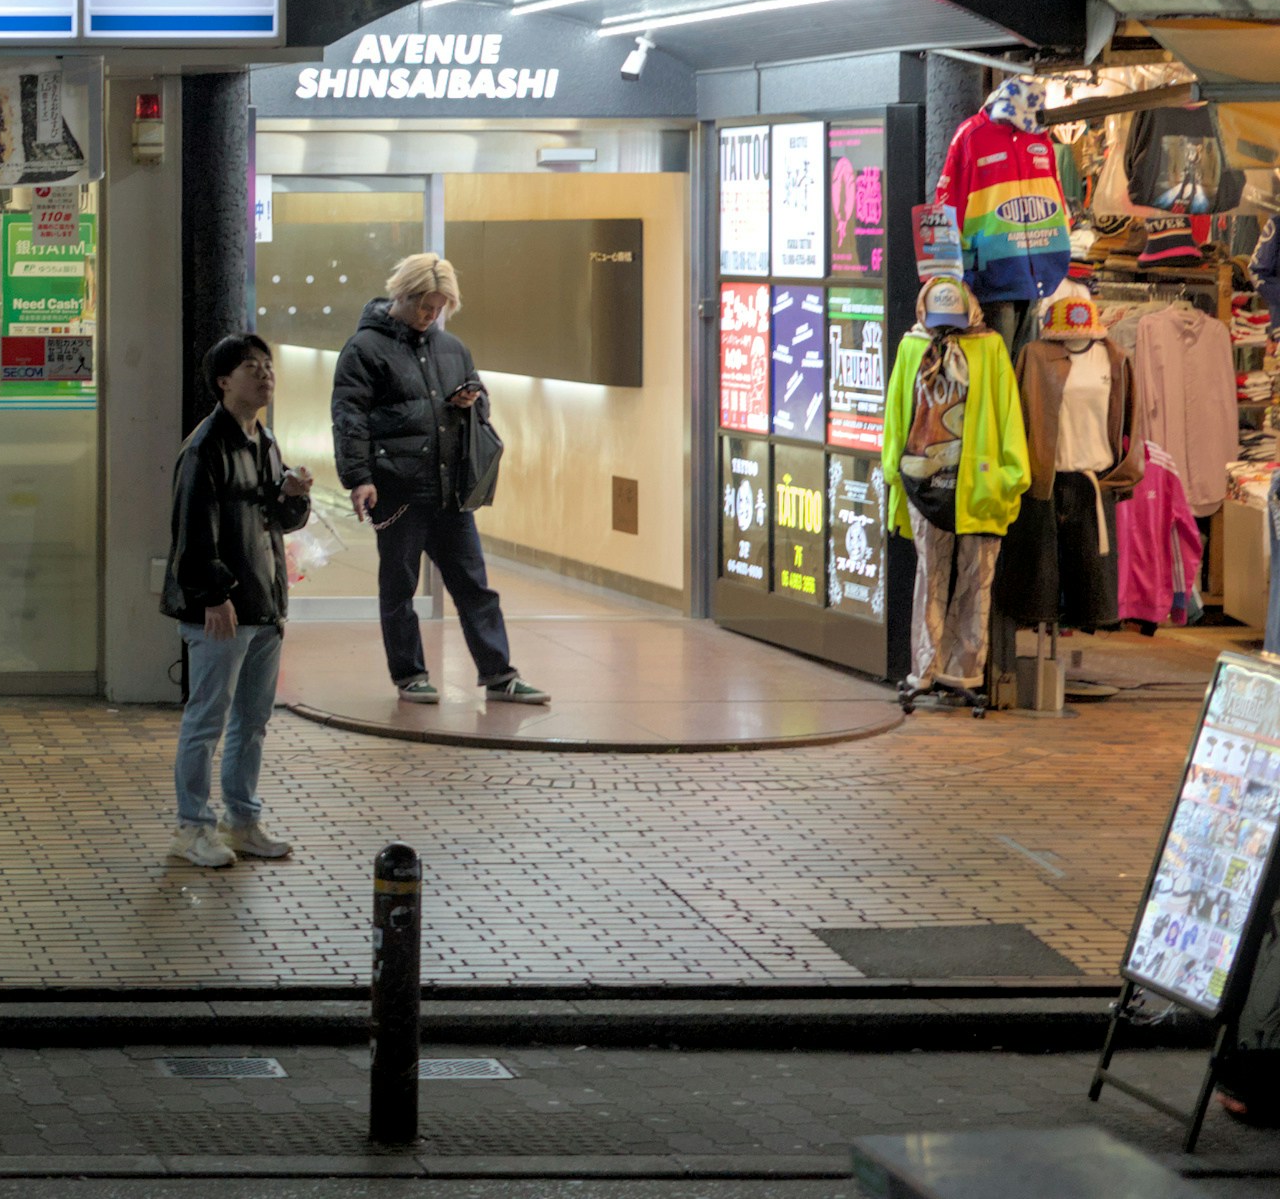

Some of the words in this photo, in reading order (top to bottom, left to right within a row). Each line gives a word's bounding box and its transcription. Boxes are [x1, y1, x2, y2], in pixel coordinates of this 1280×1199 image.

[352, 33, 503, 65] AVENUE
[295, 67, 559, 100] SHINSAIBASHI
[1001, 197, 1054, 222] DUPONT
[13, 298, 45, 310] Need
[3, 367, 43, 378] SECOM
[777, 483, 823, 534] TATTOO
